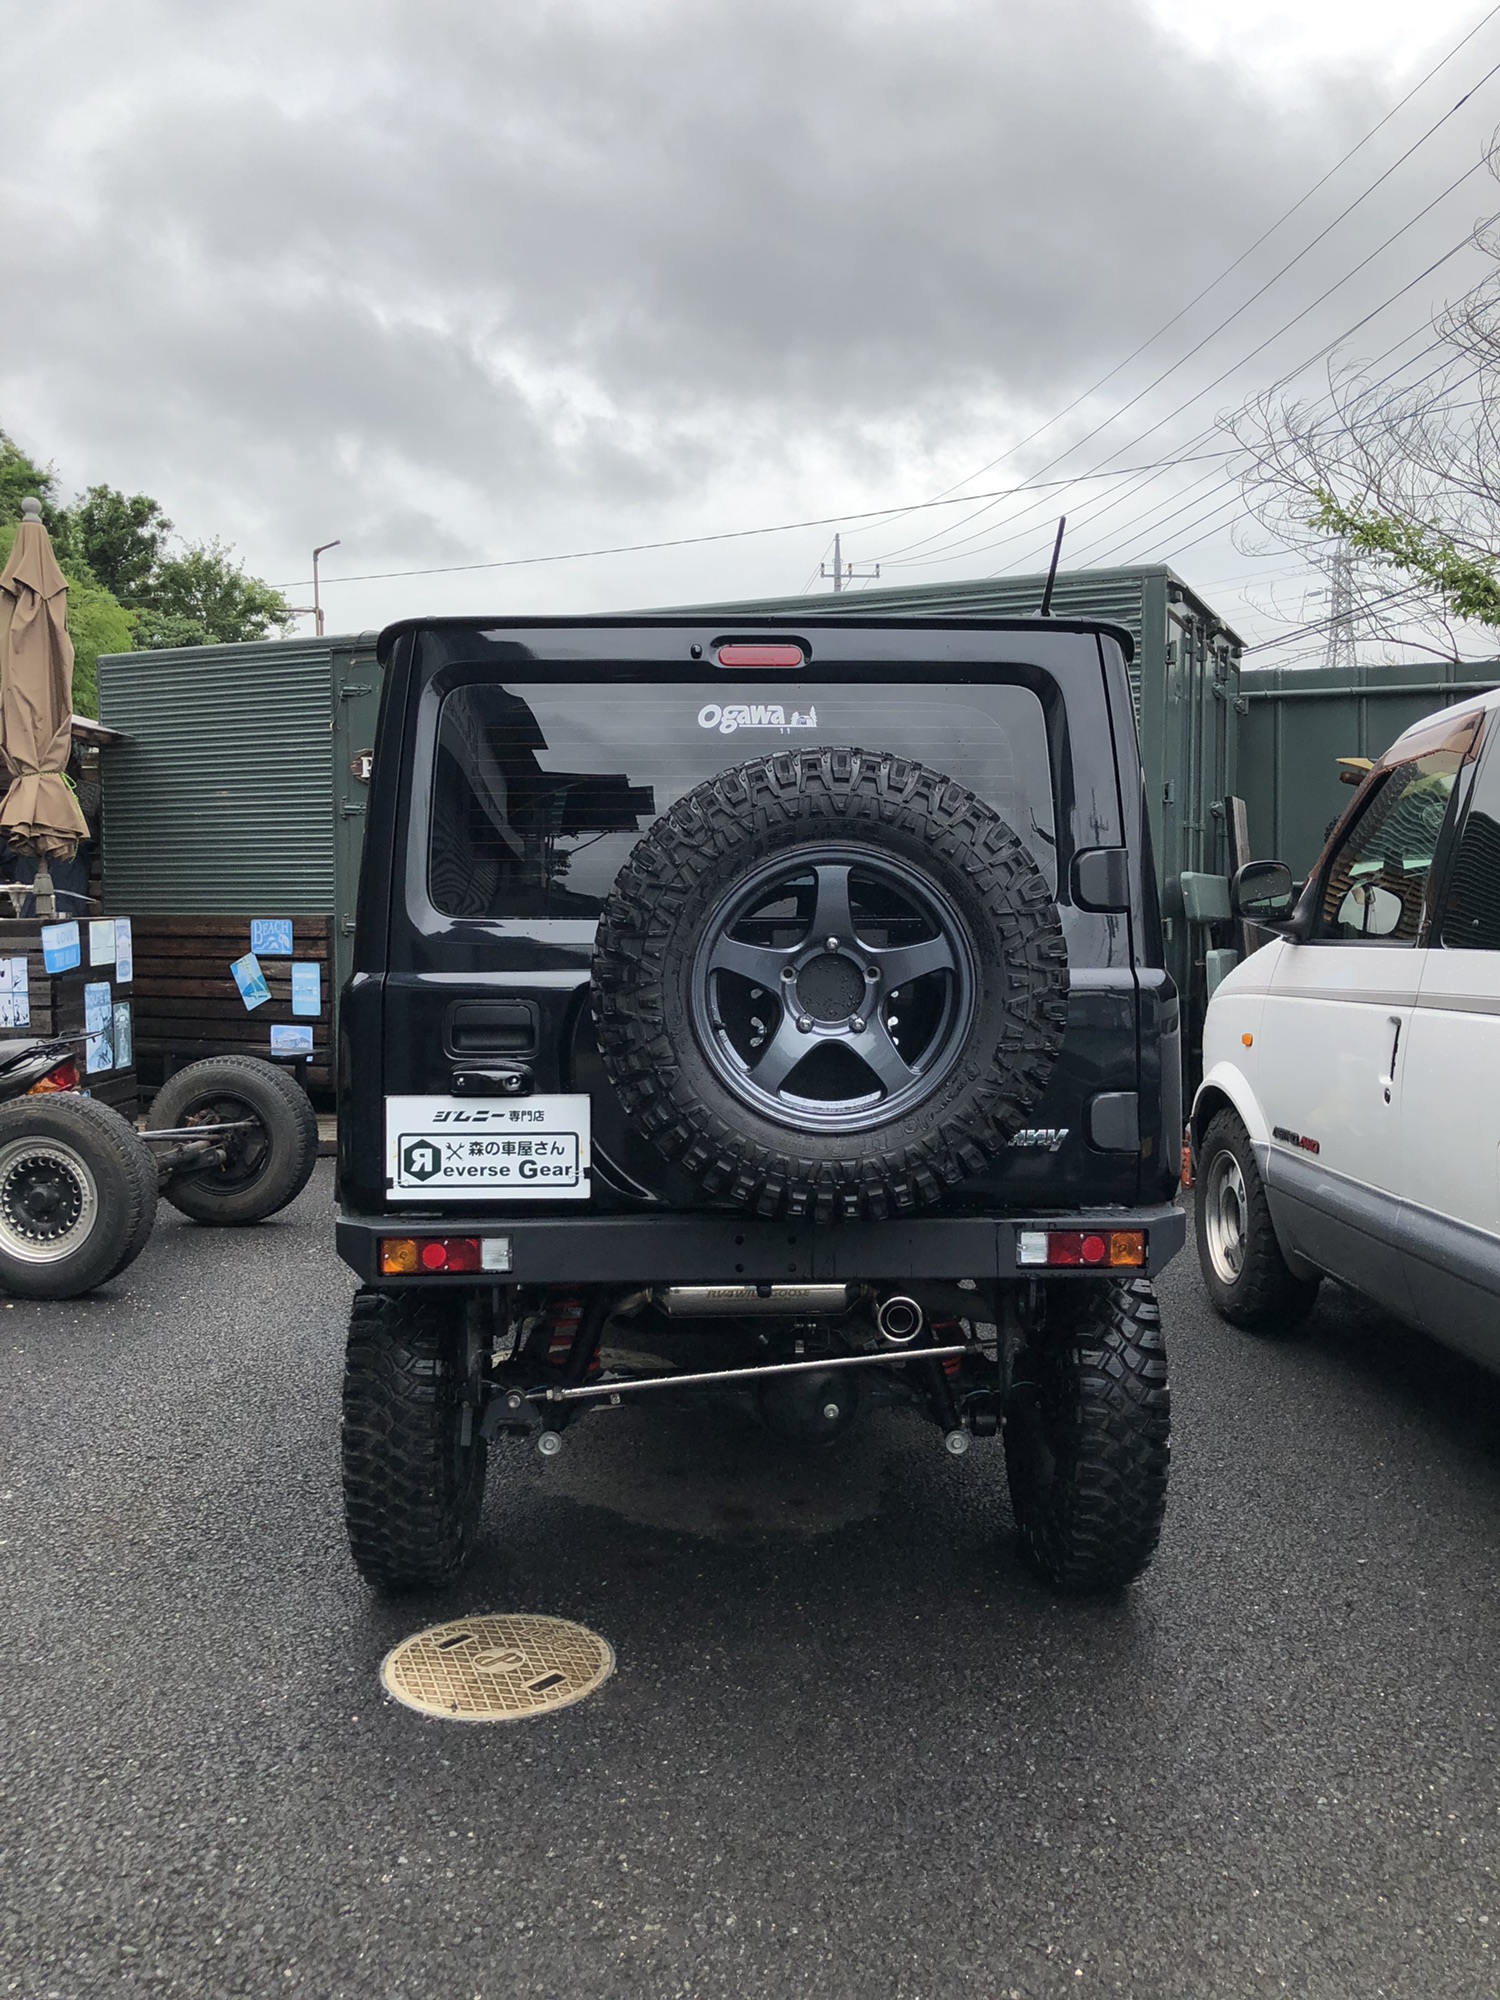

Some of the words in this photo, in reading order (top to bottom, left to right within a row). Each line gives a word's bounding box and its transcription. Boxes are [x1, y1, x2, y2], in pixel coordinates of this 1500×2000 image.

[254, 920, 290, 945] BEACH
[468, 1140, 565, 1157] 森の車屋さん
[518, 1159, 573, 1179] Gear
[706, 1289, 758, 1298] RV4WIL
